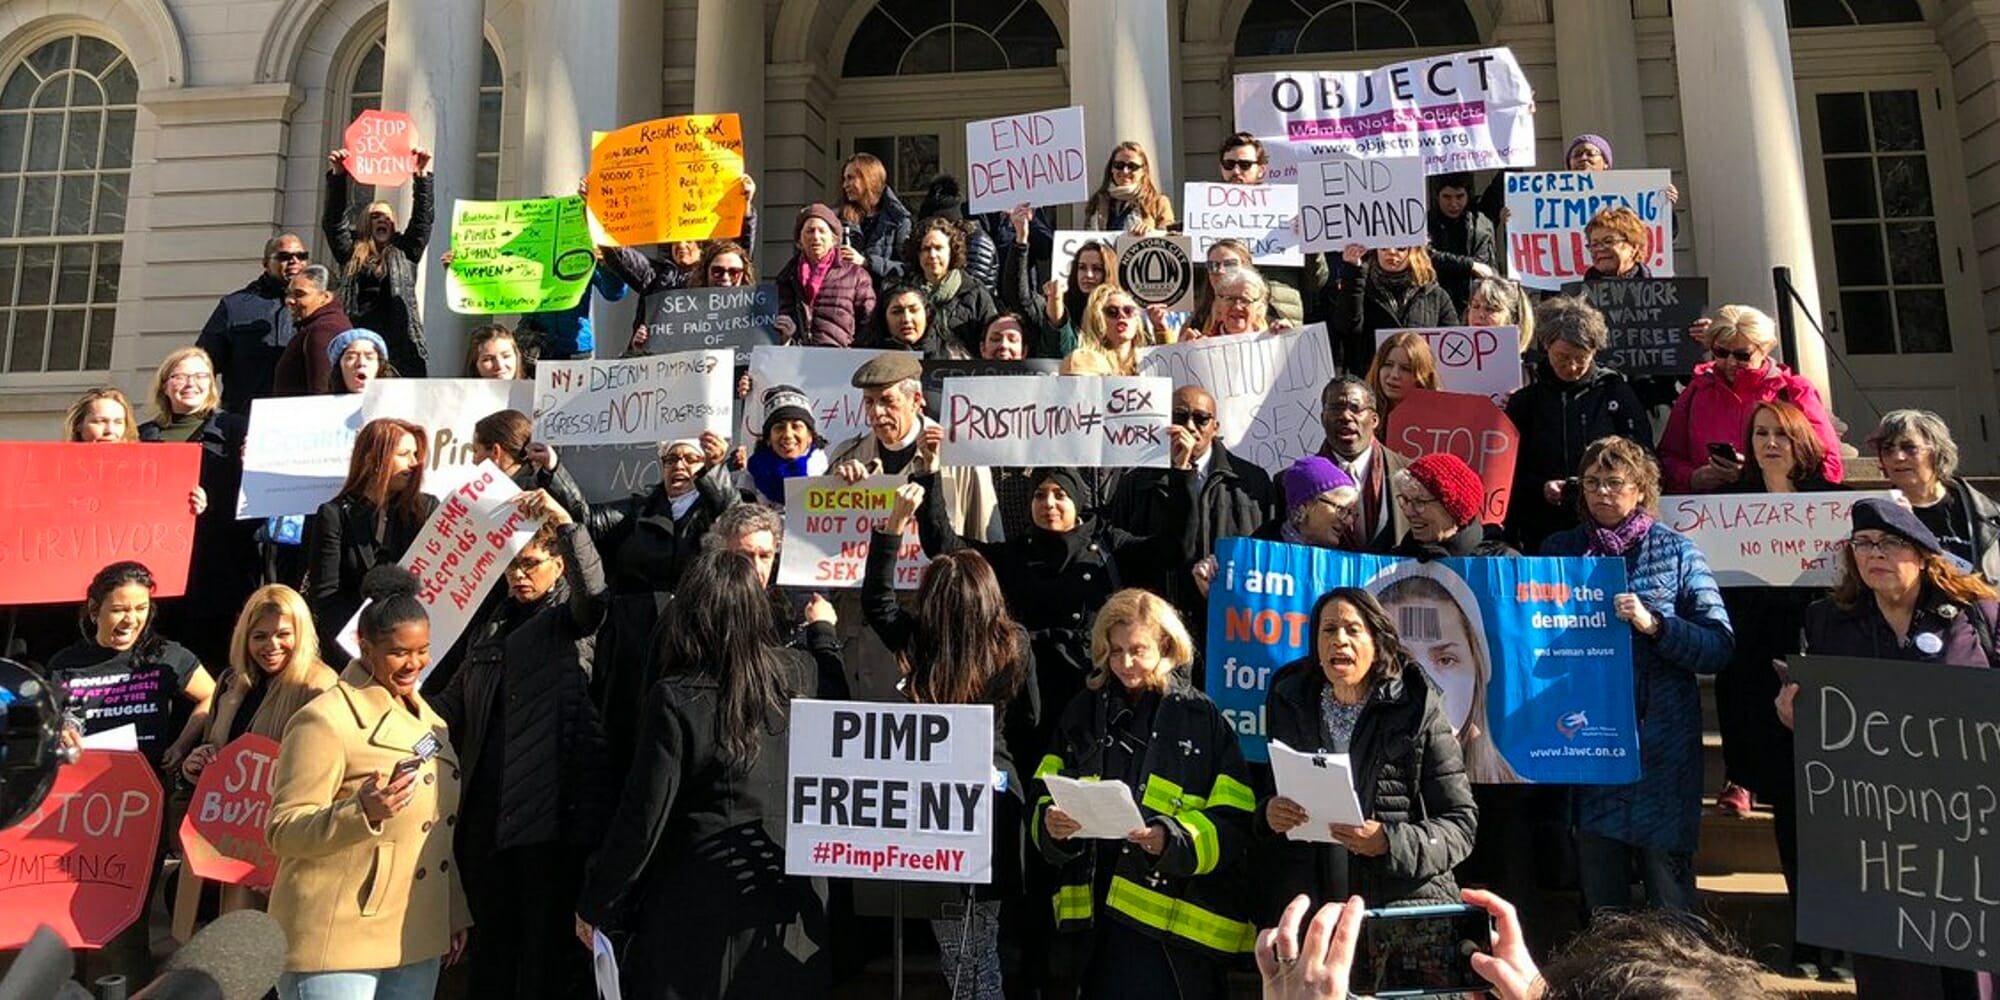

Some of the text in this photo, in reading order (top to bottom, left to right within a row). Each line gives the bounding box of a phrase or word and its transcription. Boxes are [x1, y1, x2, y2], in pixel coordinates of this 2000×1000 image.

[1271, 56, 1493, 112] OBJECT
[361, 116, 406, 136] STOP
[991, 115, 1054, 151] END
[1291, 123, 1354, 136] Women
[1358, 117, 1389, 131] Not
[355, 136, 389, 154] SEX
[1425, 153, 1448, 165] and
[971, 149, 1084, 198] DEMAND
[1320, 160, 1392, 197] END
[1207, 186, 1272, 208] DONT
[1189, 212, 1291, 230] LEGALIZE
[1301, 198, 1426, 243] DEMAND
[1131, 249, 1180, 284] NOW
[1511, 231, 1590, 277] HELL
[662, 289, 767, 313] SEX BUYING
[1628, 281, 1679, 308] YORK
[650, 322, 675, 337] THE
[716, 313, 776, 331] VERSION
[1608, 306, 1662, 324] WANT
[704, 334, 726, 346] OF
[1626, 327, 1681, 347] FREE
[1610, 347, 1677, 368] STATE
[590, 363, 649, 392] DECRIM
[608, 391, 655, 434] NOT
[949, 393, 1081, 443] PROSTITUTION
[1106, 387, 1154, 414] SEX
[1250, 399, 1320, 440] SEX
[1103, 423, 1161, 447] WORK
[1402, 425, 1509, 476] STOP
[809, 489, 887, 510] DECRIM
[806, 516, 847, 534] NOT
[1673, 499, 1803, 532] SALAZAR
[1741, 541, 1762, 556] NO
[1771, 539, 1806, 556] PIMP
[815, 560, 858, 582] SEX
[1245, 568, 1295, 597] am
[1516, 579, 1605, 608] stop the
[1225, 605, 1310, 648] NOT
[1531, 610, 1608, 629] demand!
[1223, 657, 1271, 690] for
[1221, 705, 1268, 736] sal
[832, 711, 949, 761] PIMP
[224, 749, 279, 795] STO
[792, 776, 985, 831] FREE NY
[1804, 760, 1996, 842] Pimping?
[813, 842, 965, 873] #PimpFreeNY
[1860, 839, 2000, 905] HELL
[1898, 906, 1987, 958] NO!
